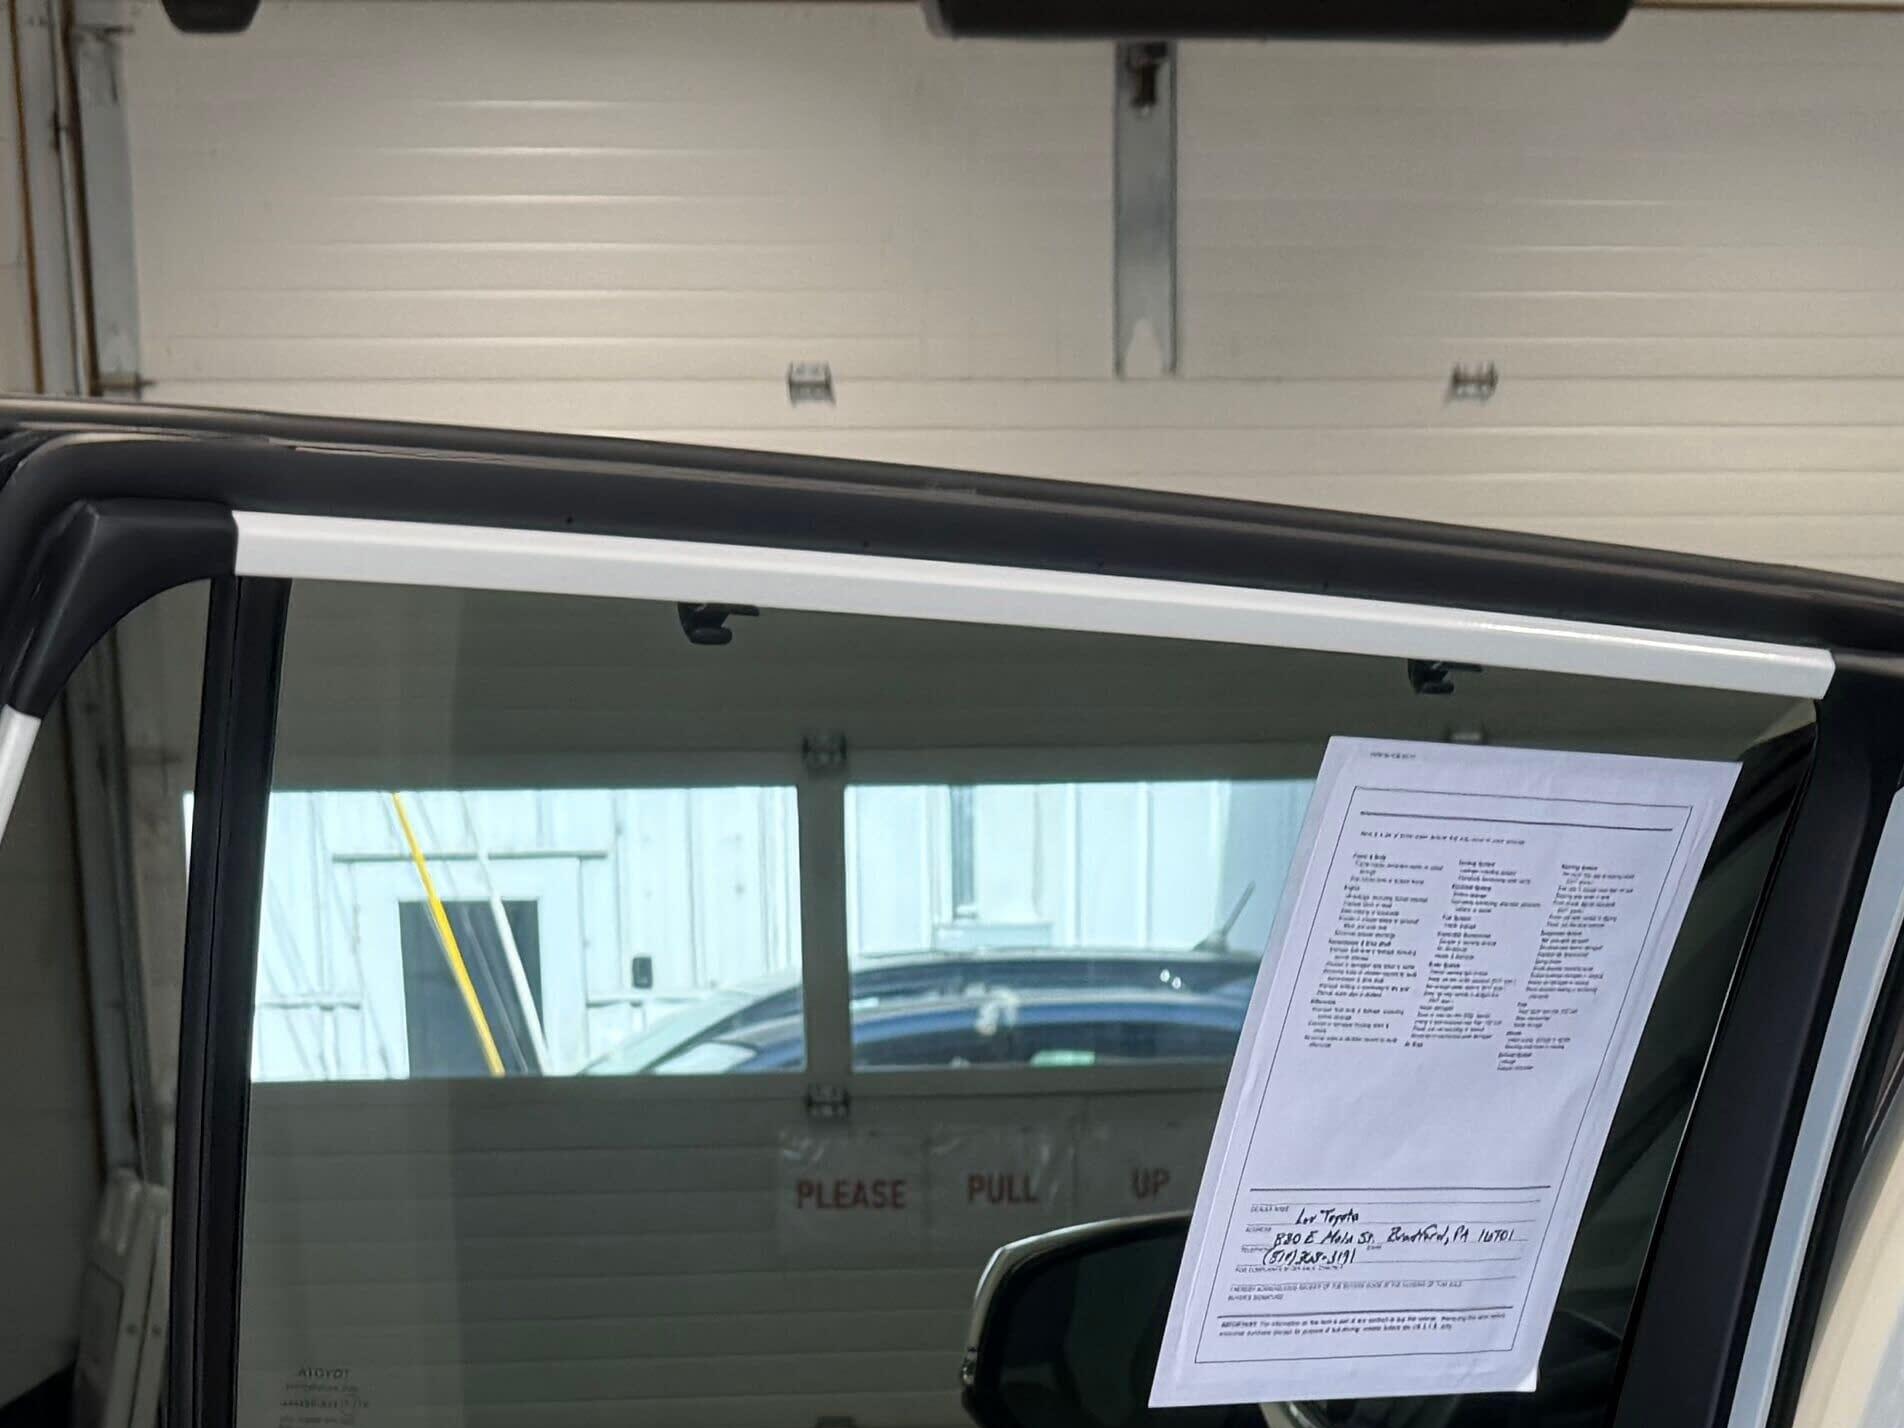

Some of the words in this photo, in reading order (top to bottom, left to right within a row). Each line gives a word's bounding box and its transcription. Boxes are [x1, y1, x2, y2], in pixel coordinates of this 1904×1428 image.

[796, 1179, 907, 1210] PLEASE
[967, 1171, 1039, 1204] PULL
[1130, 1168, 1172, 1199] UP
[1320, 1208, 1359, 1228] Toyota
[1304, 1231, 1318, 1244] E
[1453, 1225, 1469, 1242] PA
